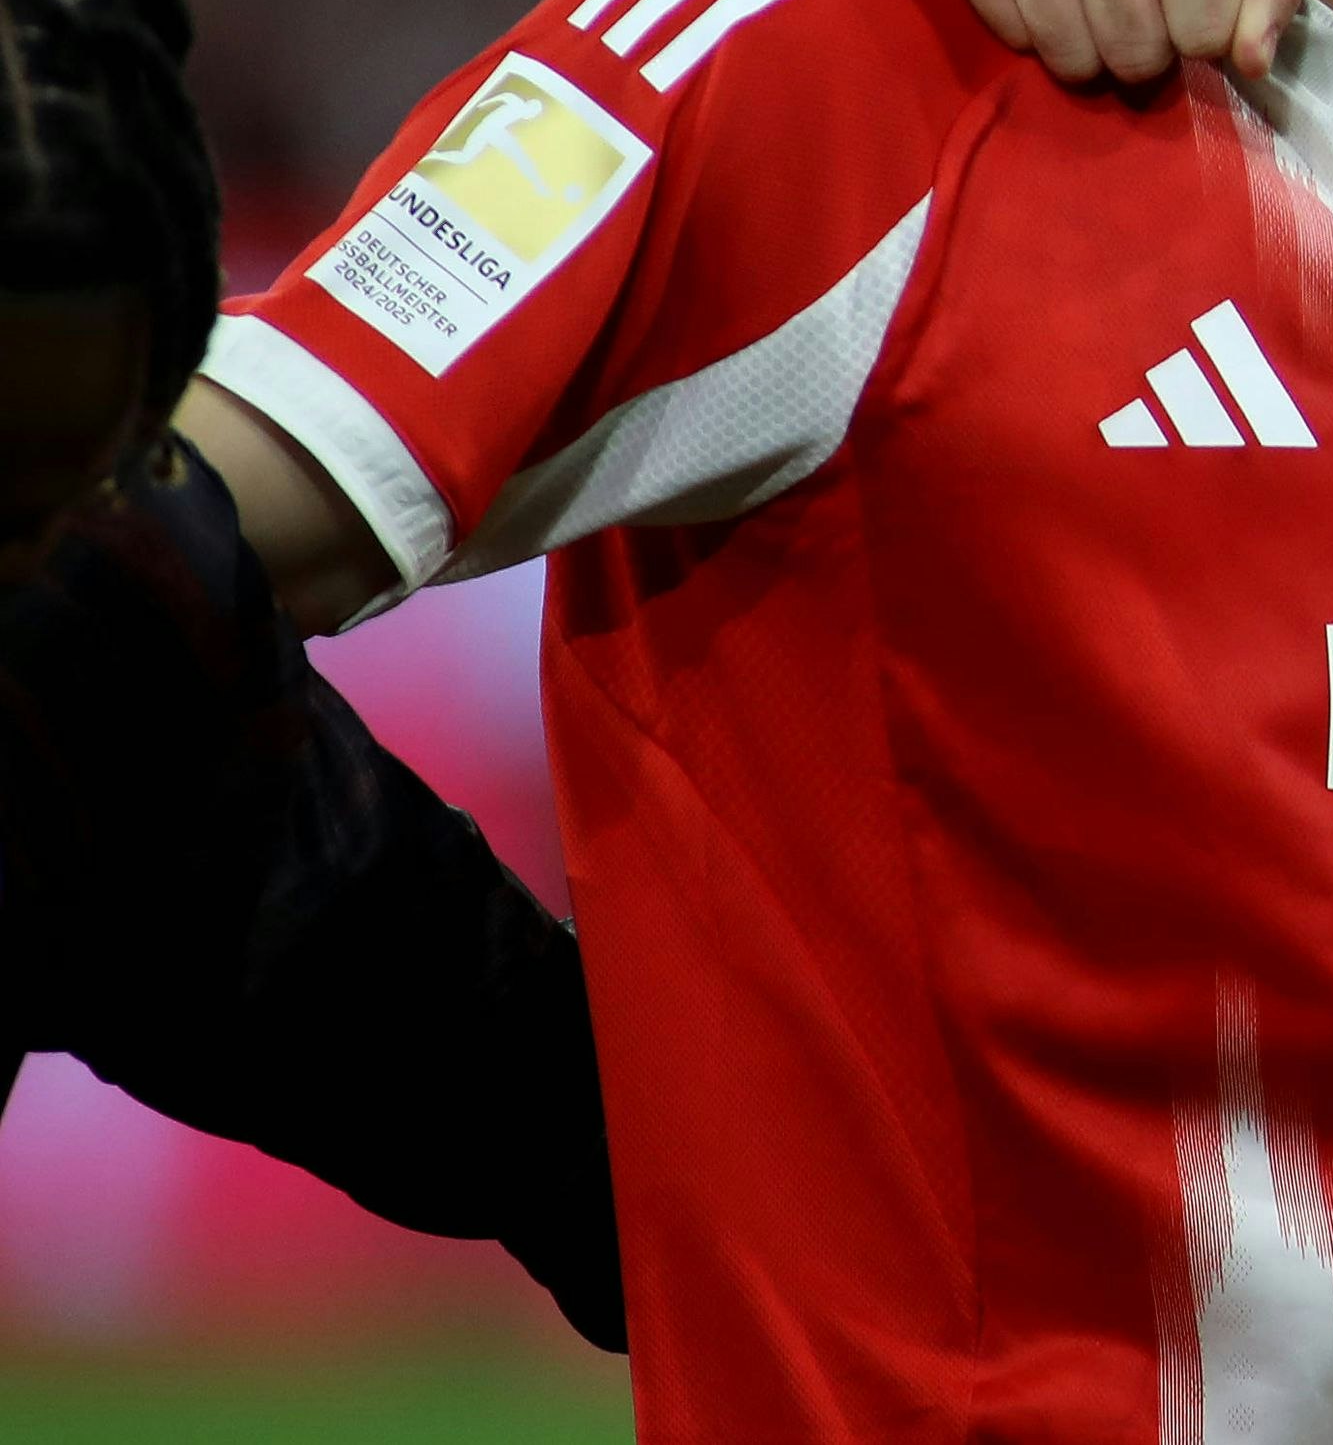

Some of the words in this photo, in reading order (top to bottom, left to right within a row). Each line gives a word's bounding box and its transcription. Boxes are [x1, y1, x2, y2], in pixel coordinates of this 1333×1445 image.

[356, 230, 447, 305] DEUTSCHER
[388, 184, 512, 291] UNDESLIGA
[334, 260, 415, 325] 2024/2025
[337, 239, 458, 338] SSBALLMEISTER
